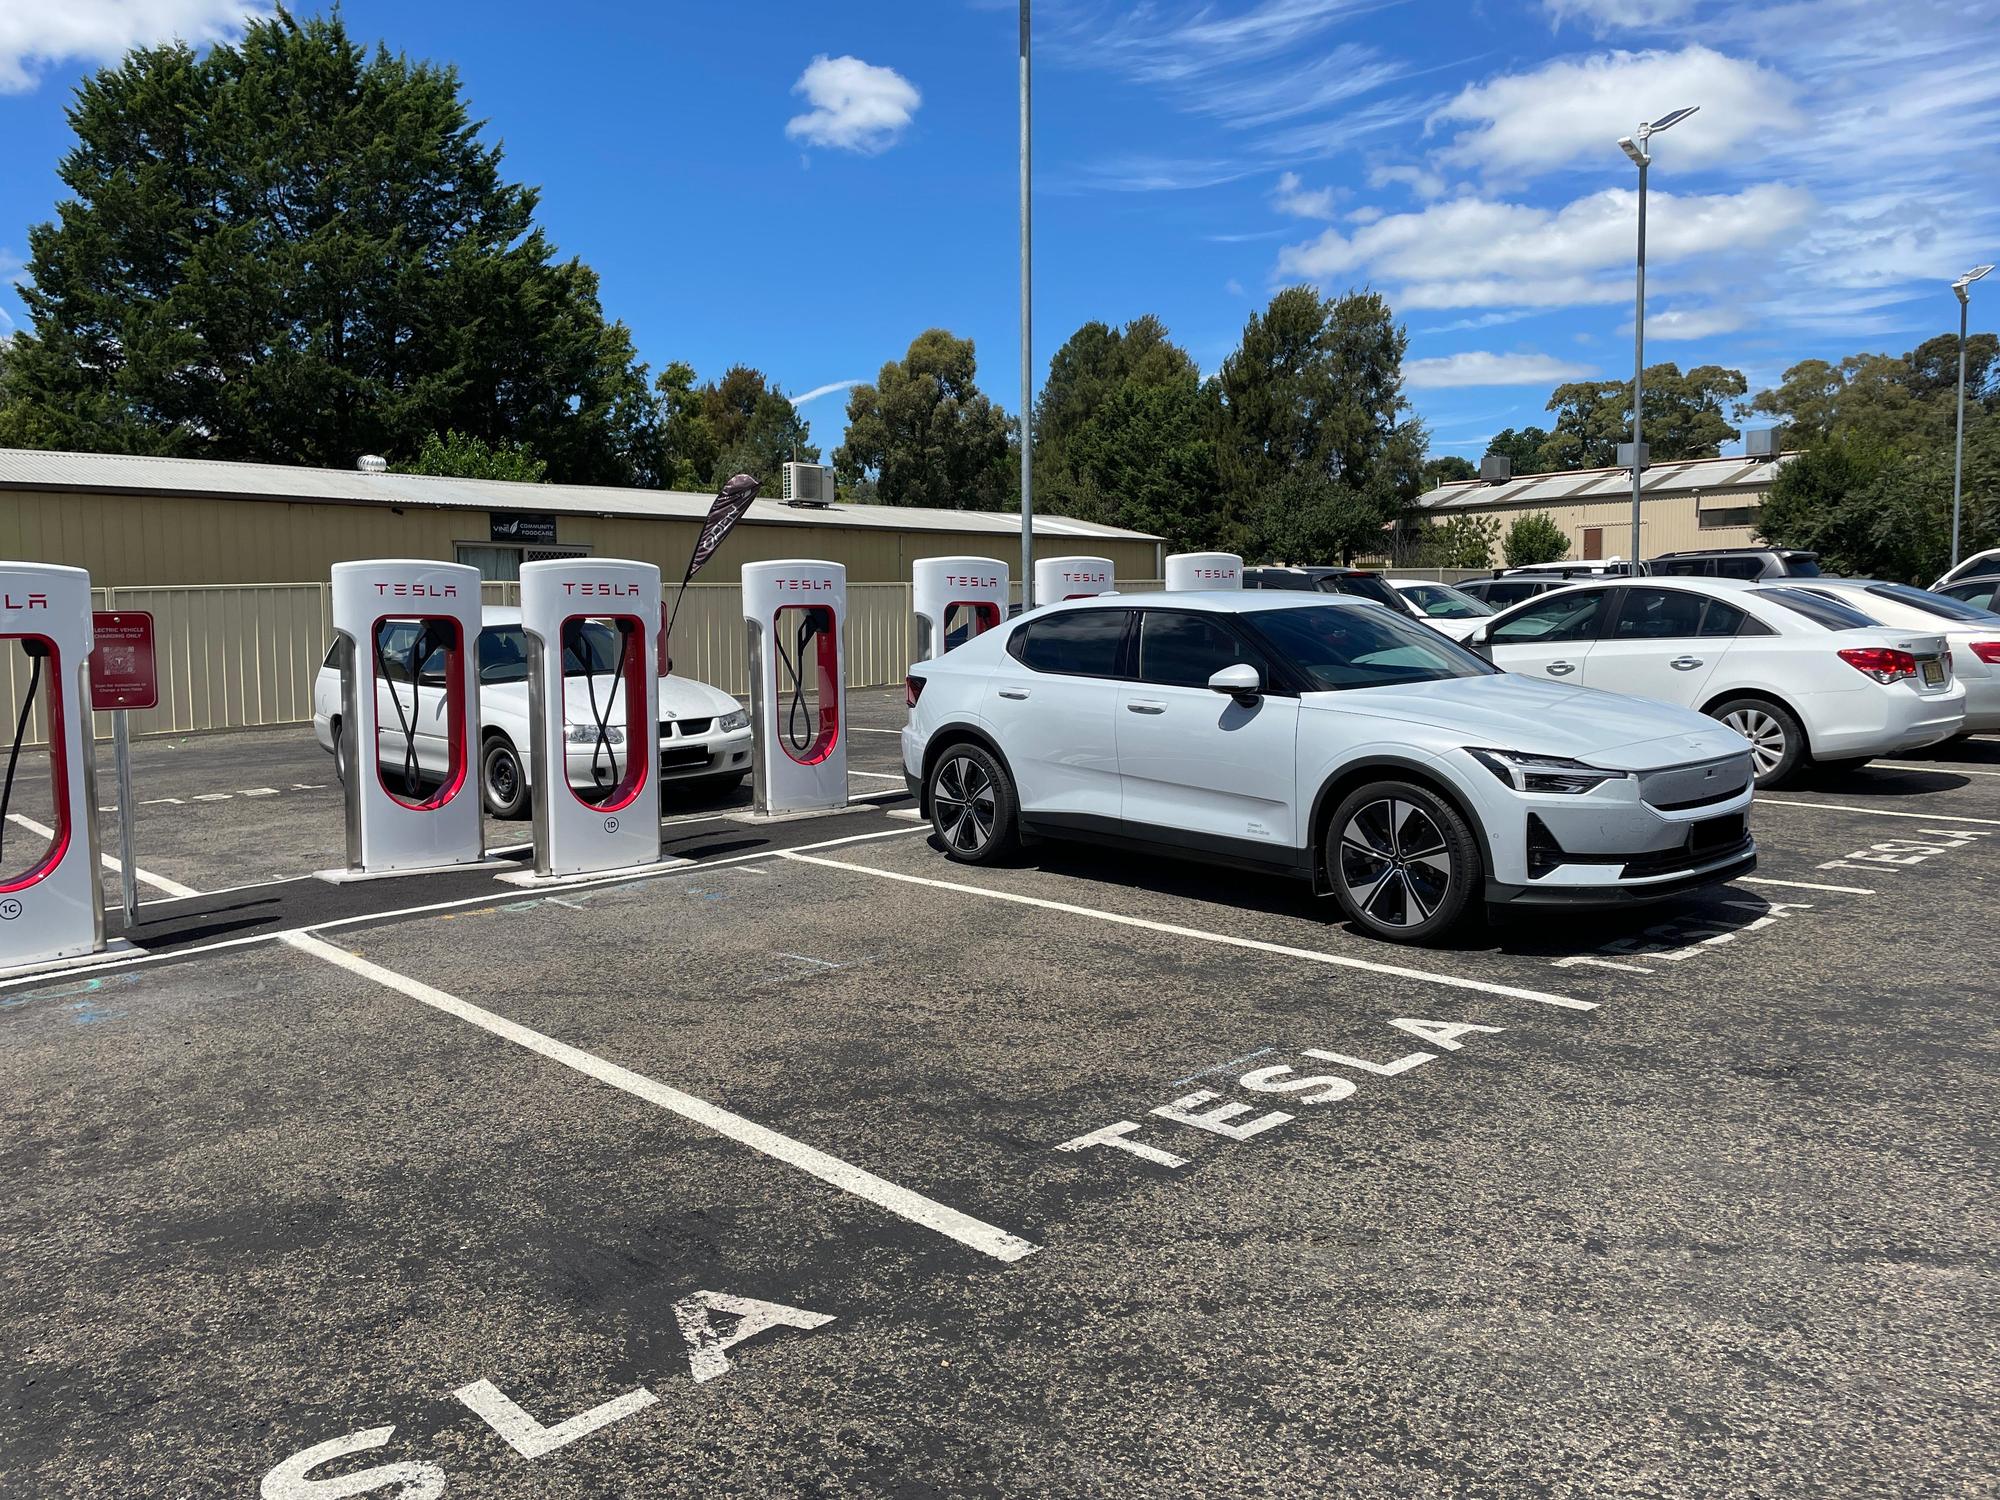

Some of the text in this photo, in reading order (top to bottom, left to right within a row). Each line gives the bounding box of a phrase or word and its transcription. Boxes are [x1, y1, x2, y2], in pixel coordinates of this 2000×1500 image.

[1063, 573, 1105, 583] TESLA
[1194, 569, 1235, 579] TESLA
[775, 579, 832, 591] TESLA
[946, 576, 997, 588] TESLA
[374, 583, 457, 598] TESLA
[562, 583, 639, 597] TESLA
[607, 821, 617, 829] 1D
[1815, 829, 1992, 873] TESLA
[2, 904, 17, 914] 1C
[1053, 1017, 1508, 1169] TESLA
